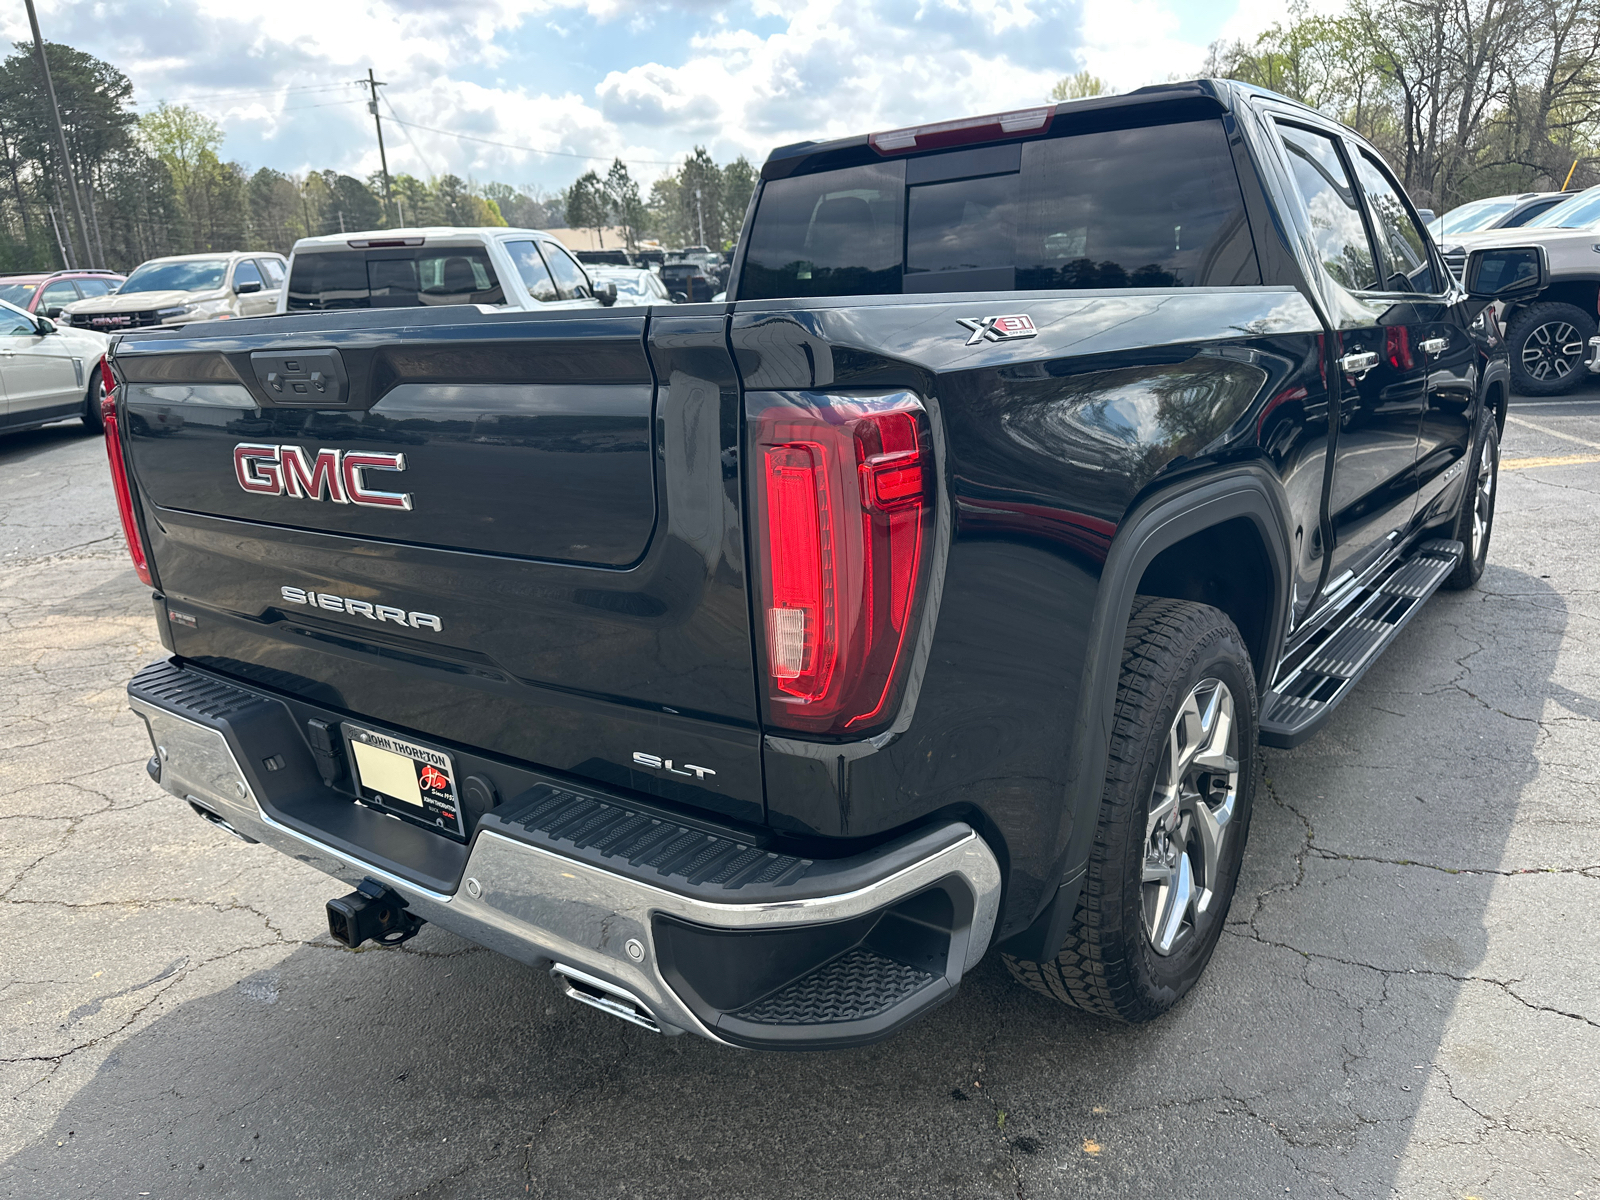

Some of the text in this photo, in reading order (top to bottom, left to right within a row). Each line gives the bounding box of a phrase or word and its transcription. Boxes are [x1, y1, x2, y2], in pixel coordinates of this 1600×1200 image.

[92, 316, 131, 326] GMC
[234, 442, 414, 511] GMC
[281, 585, 444, 632] SIERRA
[392, 741, 446, 767] THORNTON
[633, 751, 716, 781] SLT
